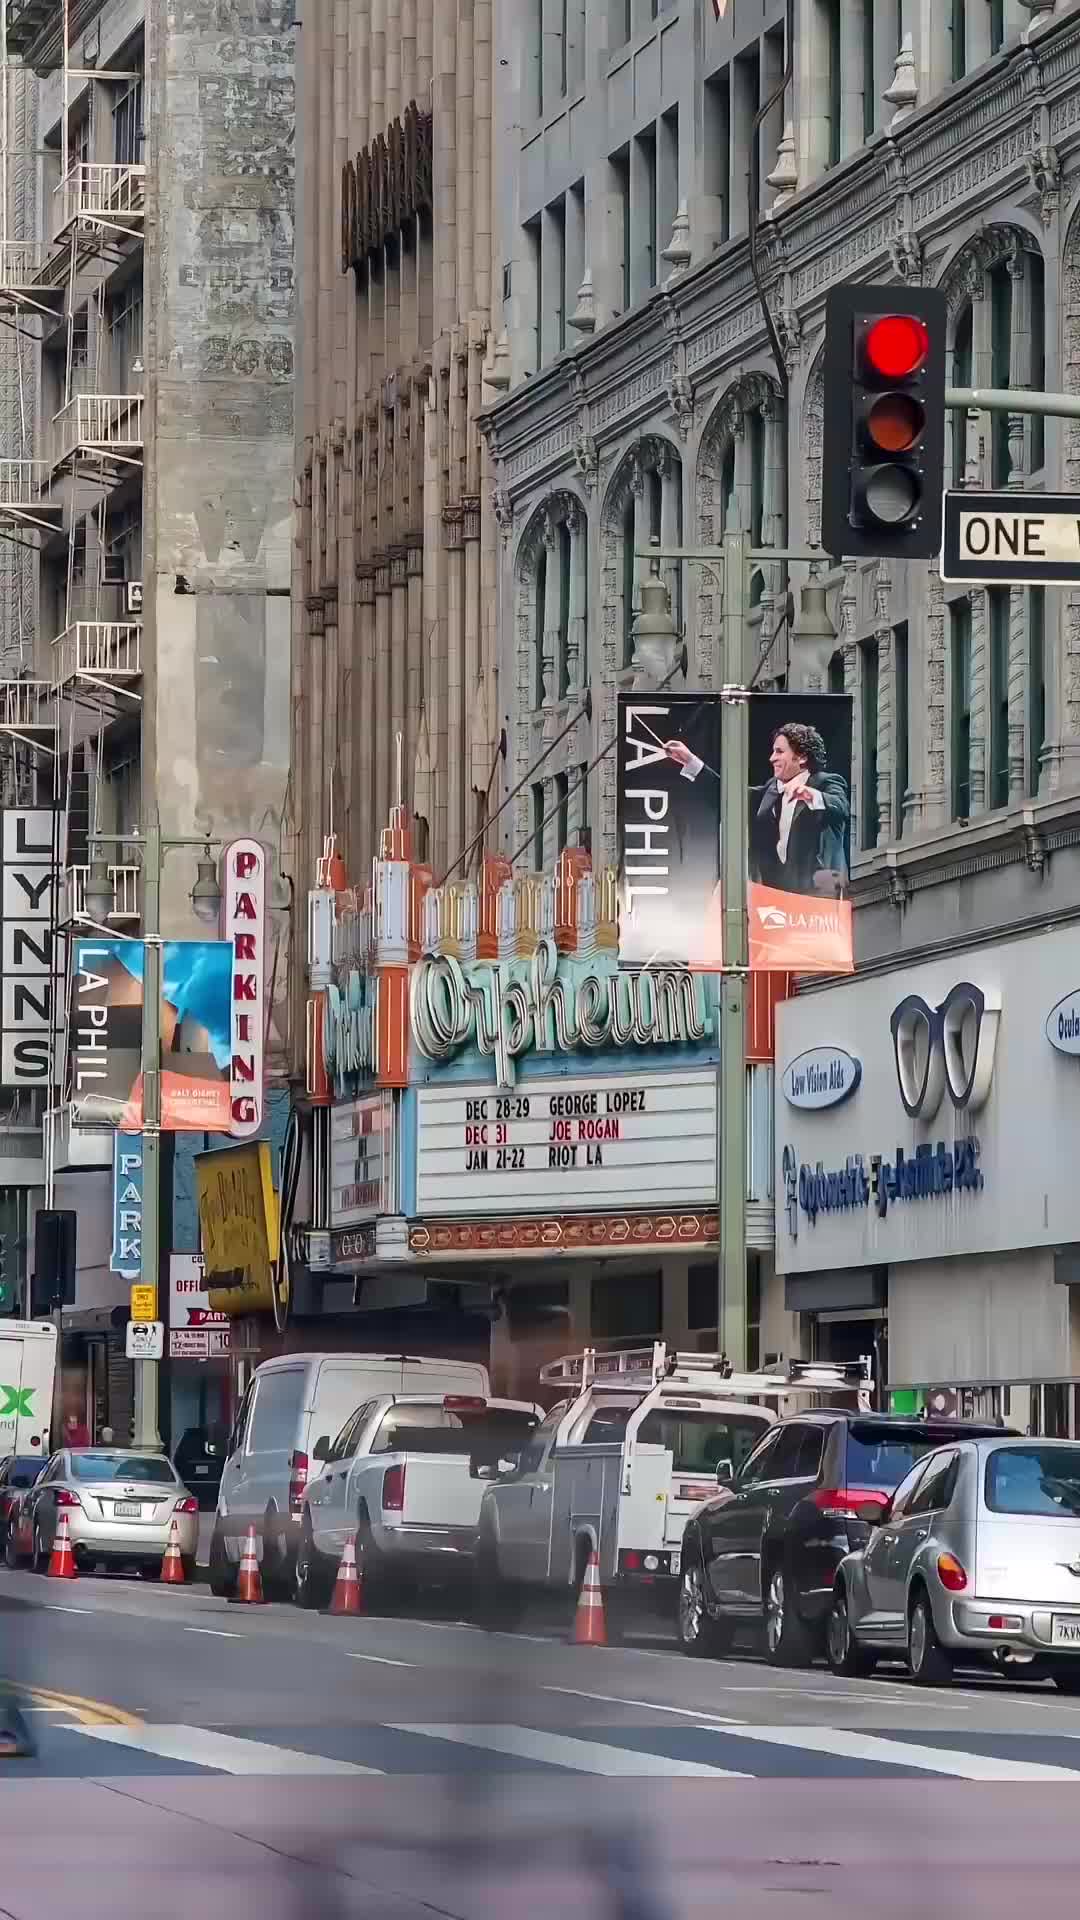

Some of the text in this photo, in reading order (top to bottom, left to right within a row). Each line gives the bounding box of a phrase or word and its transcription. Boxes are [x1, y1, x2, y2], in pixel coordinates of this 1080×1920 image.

[966, 517, 1046, 555] ONE
[625, 705, 670, 914] LA PHIL
[14, 817, 53, 1078] LYNNS
[233, 851, 257, 1124] PARKING
[77, 949, 109, 1090] LA PHIL
[410, 939, 708, 1087] Orpheum
[466, 1090, 645, 1120] DEC 28-29 GEORGE LOPEZ
[807, 1063, 828, 1095] Vision
[829, 1060, 844, 1090] Aids
[465, 1118, 619, 1144] DEC 31 JOE ROGAN
[466, 1144, 603, 1170] JAN 21-22 RIOT LA
[119, 1153, 142, 1259] PARK
